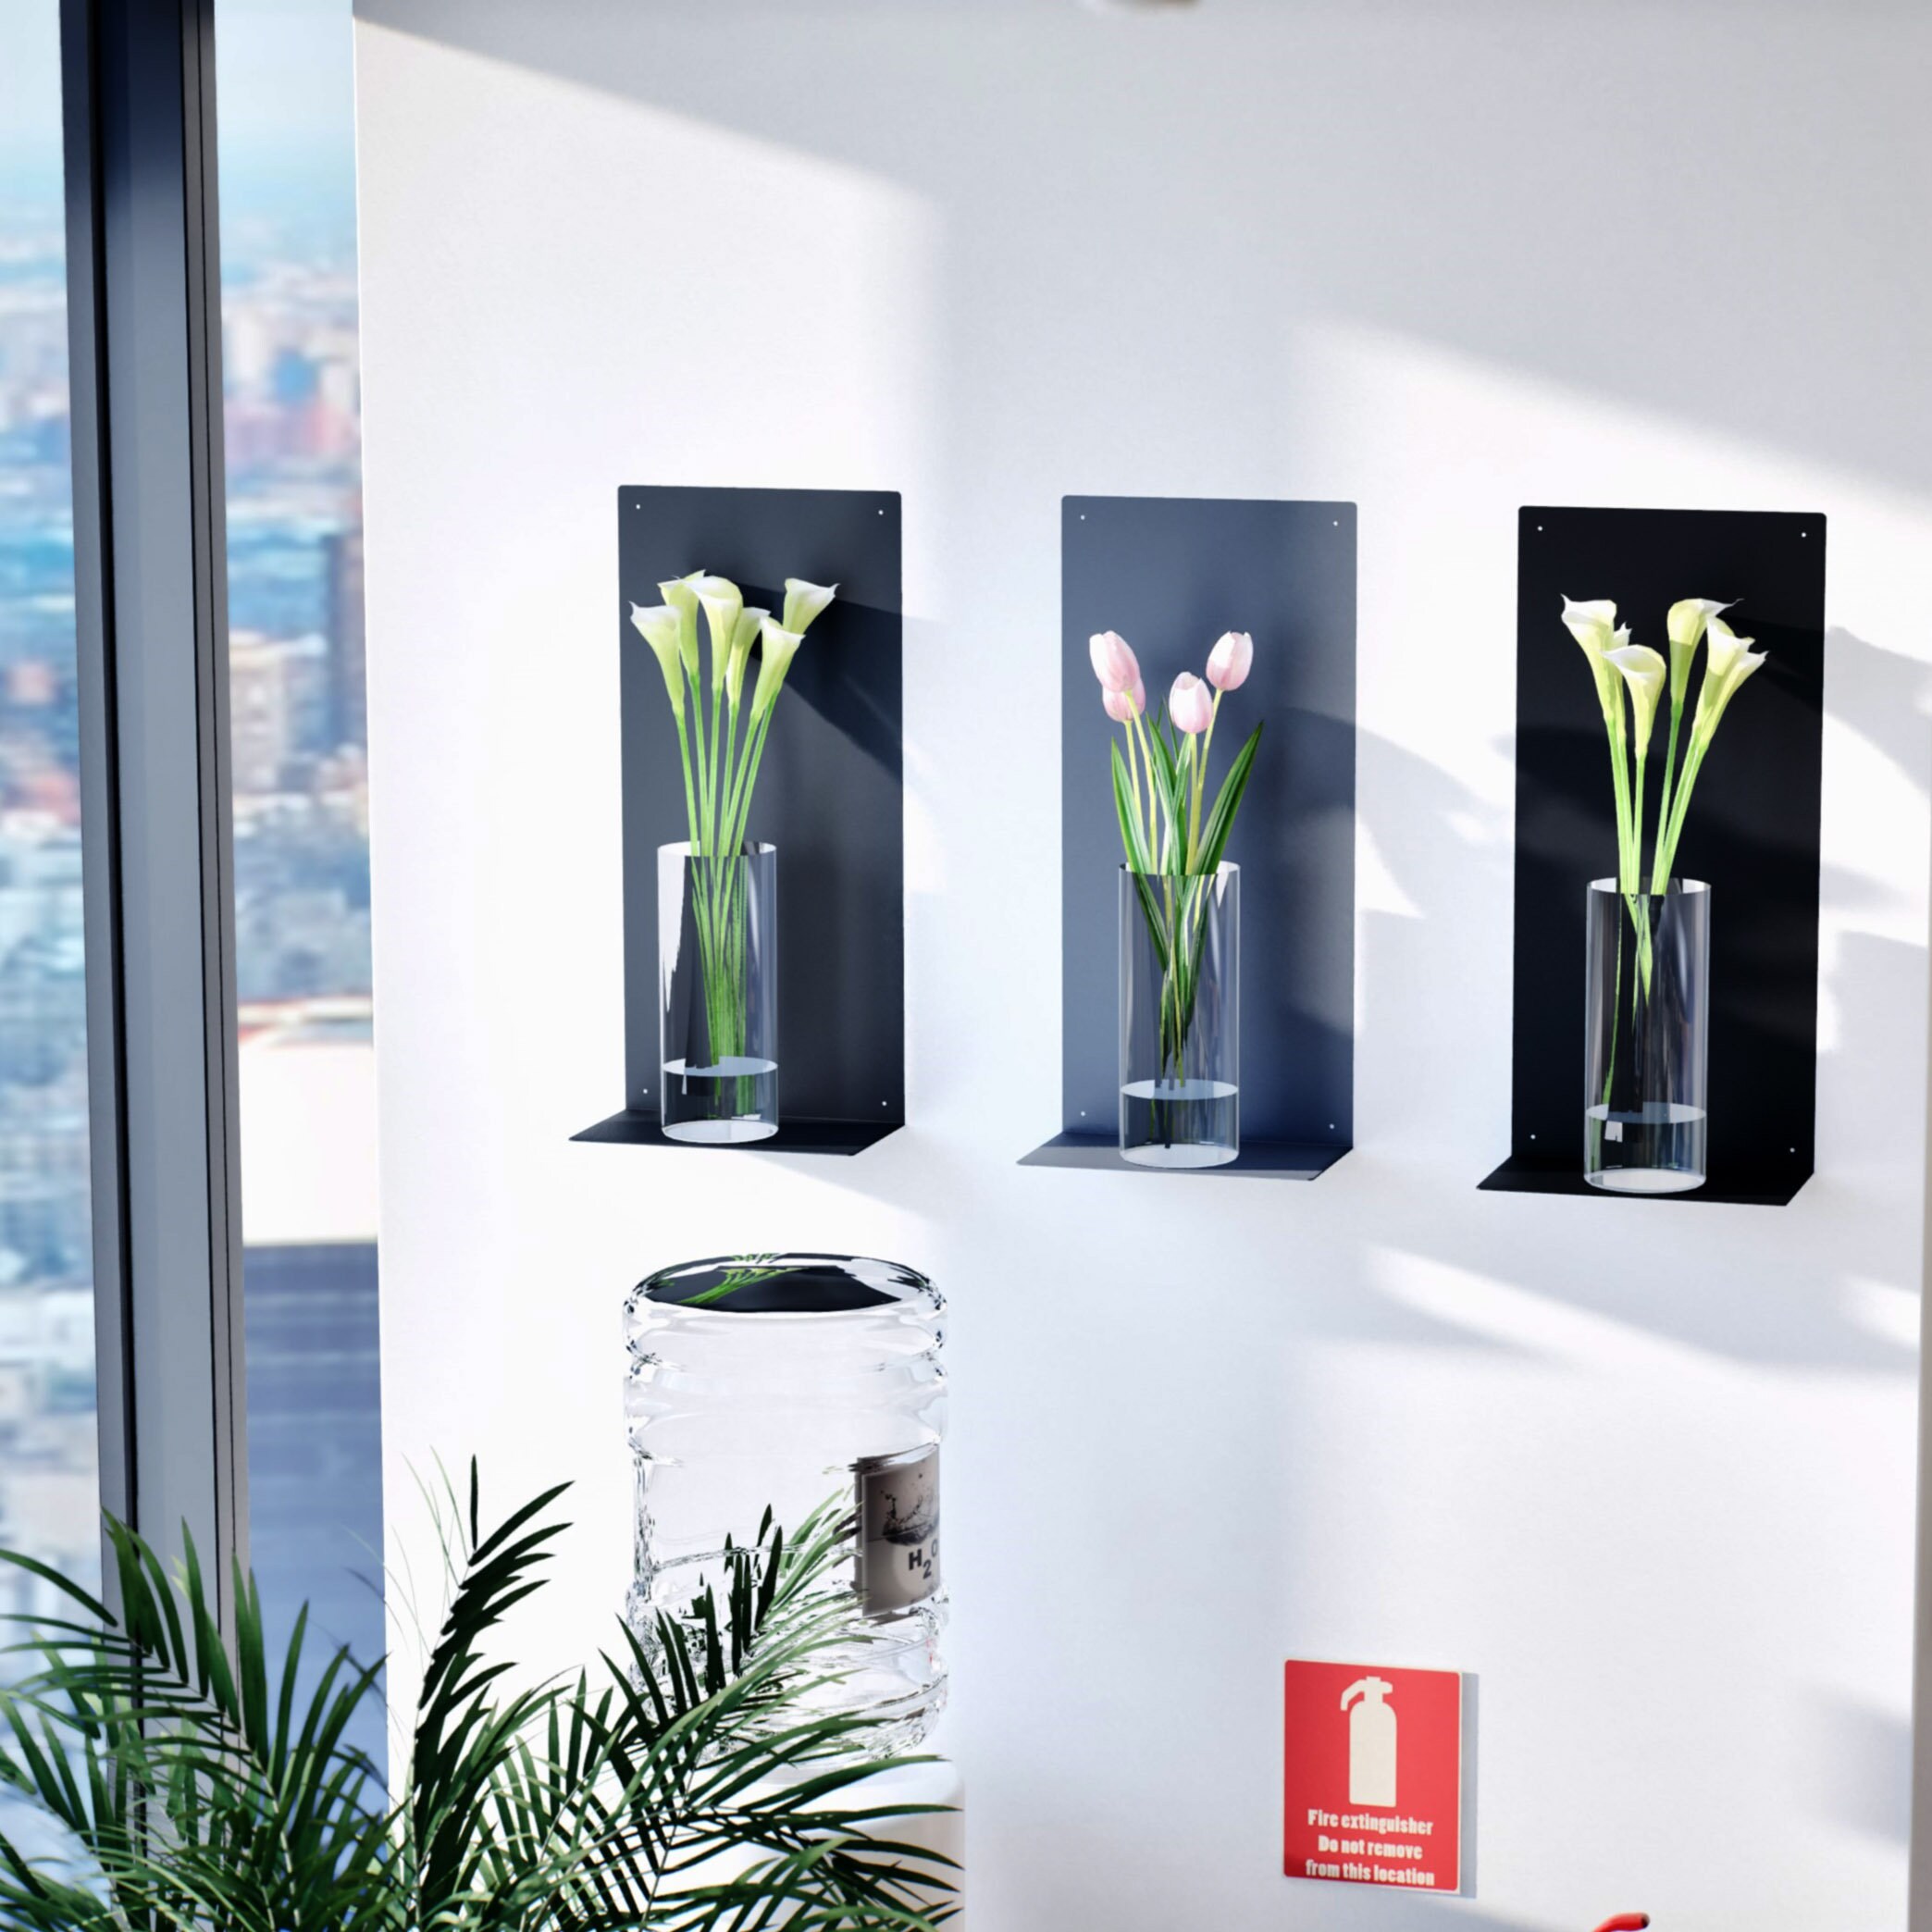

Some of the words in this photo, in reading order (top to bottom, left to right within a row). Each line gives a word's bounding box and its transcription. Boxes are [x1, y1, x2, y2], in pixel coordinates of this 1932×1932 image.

[1307, 1809, 1338, 1827] Fire
[1341, 1814, 1433, 1836] extinguisher
[1319, 1835, 1338, 1852] Do
[1341, 1839, 1365, 1855] not
[1368, 1841, 1423, 1860] remove
[1306, 1859, 1340, 1877] from
[1343, 1863, 1370, 1880] this
[1373, 1865, 1435, 1886] location
